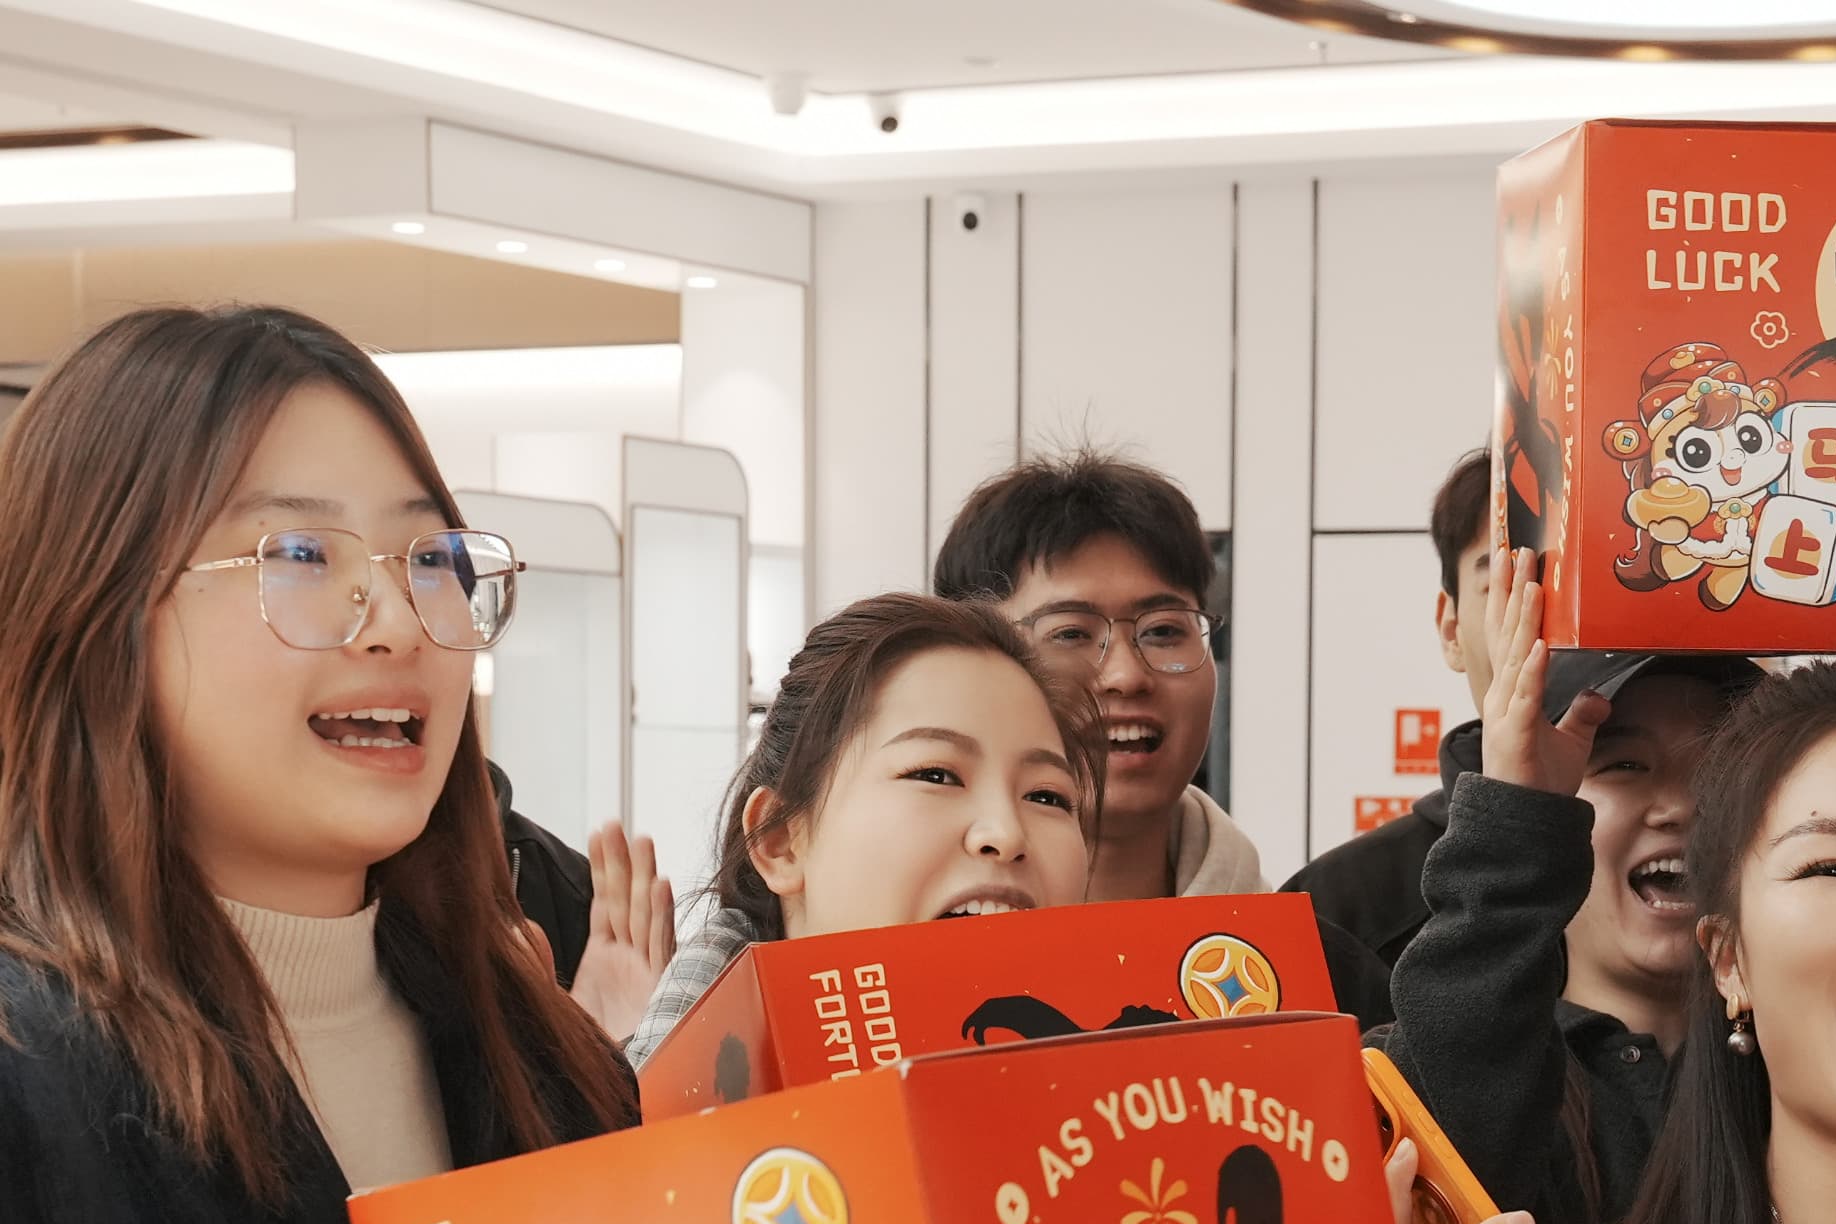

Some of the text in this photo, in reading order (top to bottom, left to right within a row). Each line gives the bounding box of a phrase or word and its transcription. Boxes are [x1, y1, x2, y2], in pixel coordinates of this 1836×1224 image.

[1646, 189, 1787, 234] GOOD
[1645, 248, 1782, 293] LUCK
[854, 963, 902, 1066] GOOD
[1037, 1076, 1315, 1197] AS YOU WISH
